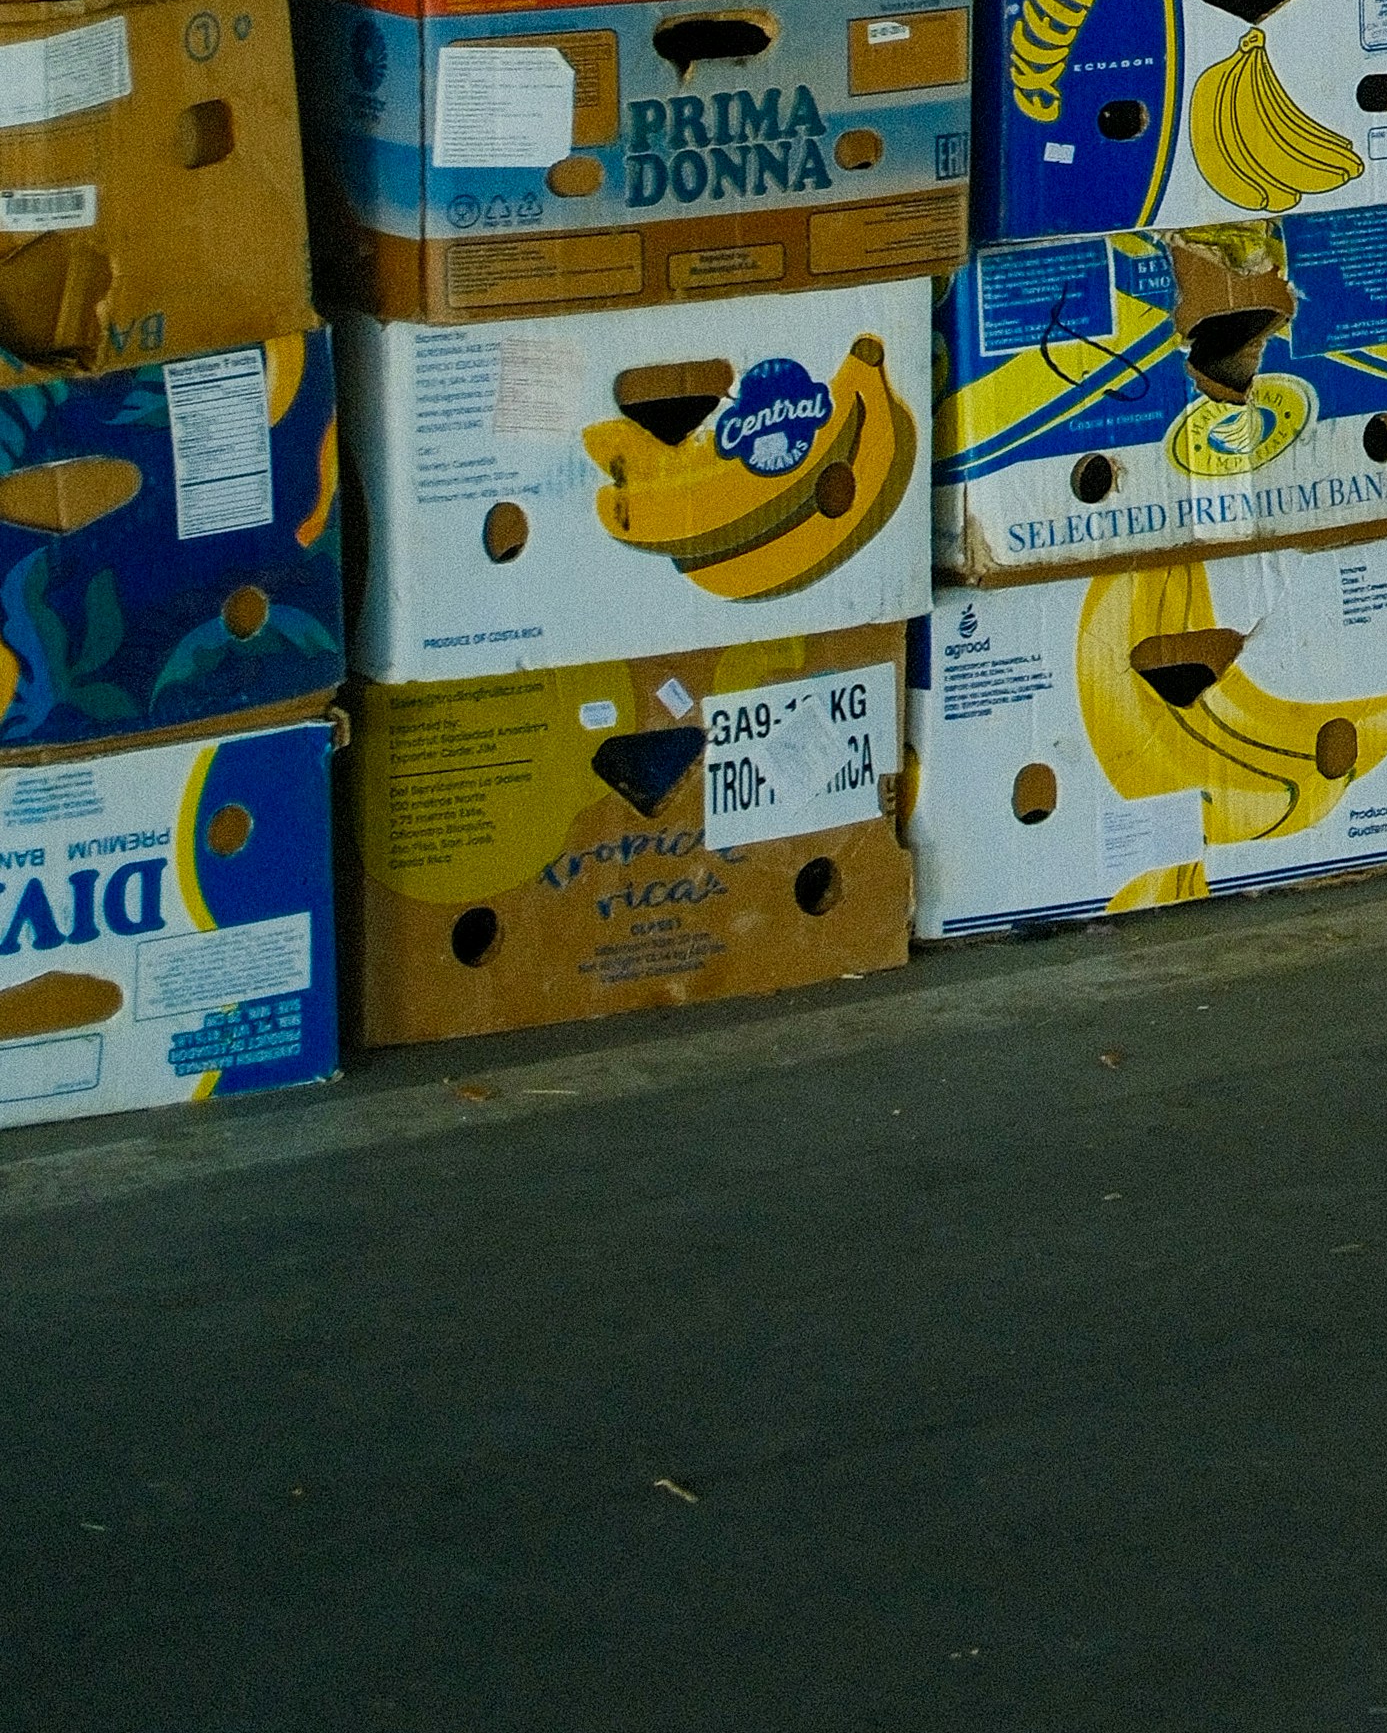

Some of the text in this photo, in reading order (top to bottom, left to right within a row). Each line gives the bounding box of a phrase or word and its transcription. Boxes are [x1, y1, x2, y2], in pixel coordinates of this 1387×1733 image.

[1073, 57, 1154, 72] ECUADOR
[627, 84, 827, 154] PRIMA
[626, 139, 833, 208] DONNA
[721, 395, 825, 448] Central
[1008, 505, 1168, 554] SELECTED
[1177, 490, 1322, 530] PREMIUM
[423, 635, 466, 650] PRODUCE
[487, 630, 515, 644] COSTA
[519, 627, 543, 640] RICA
[830, 684, 868, 724] KG
